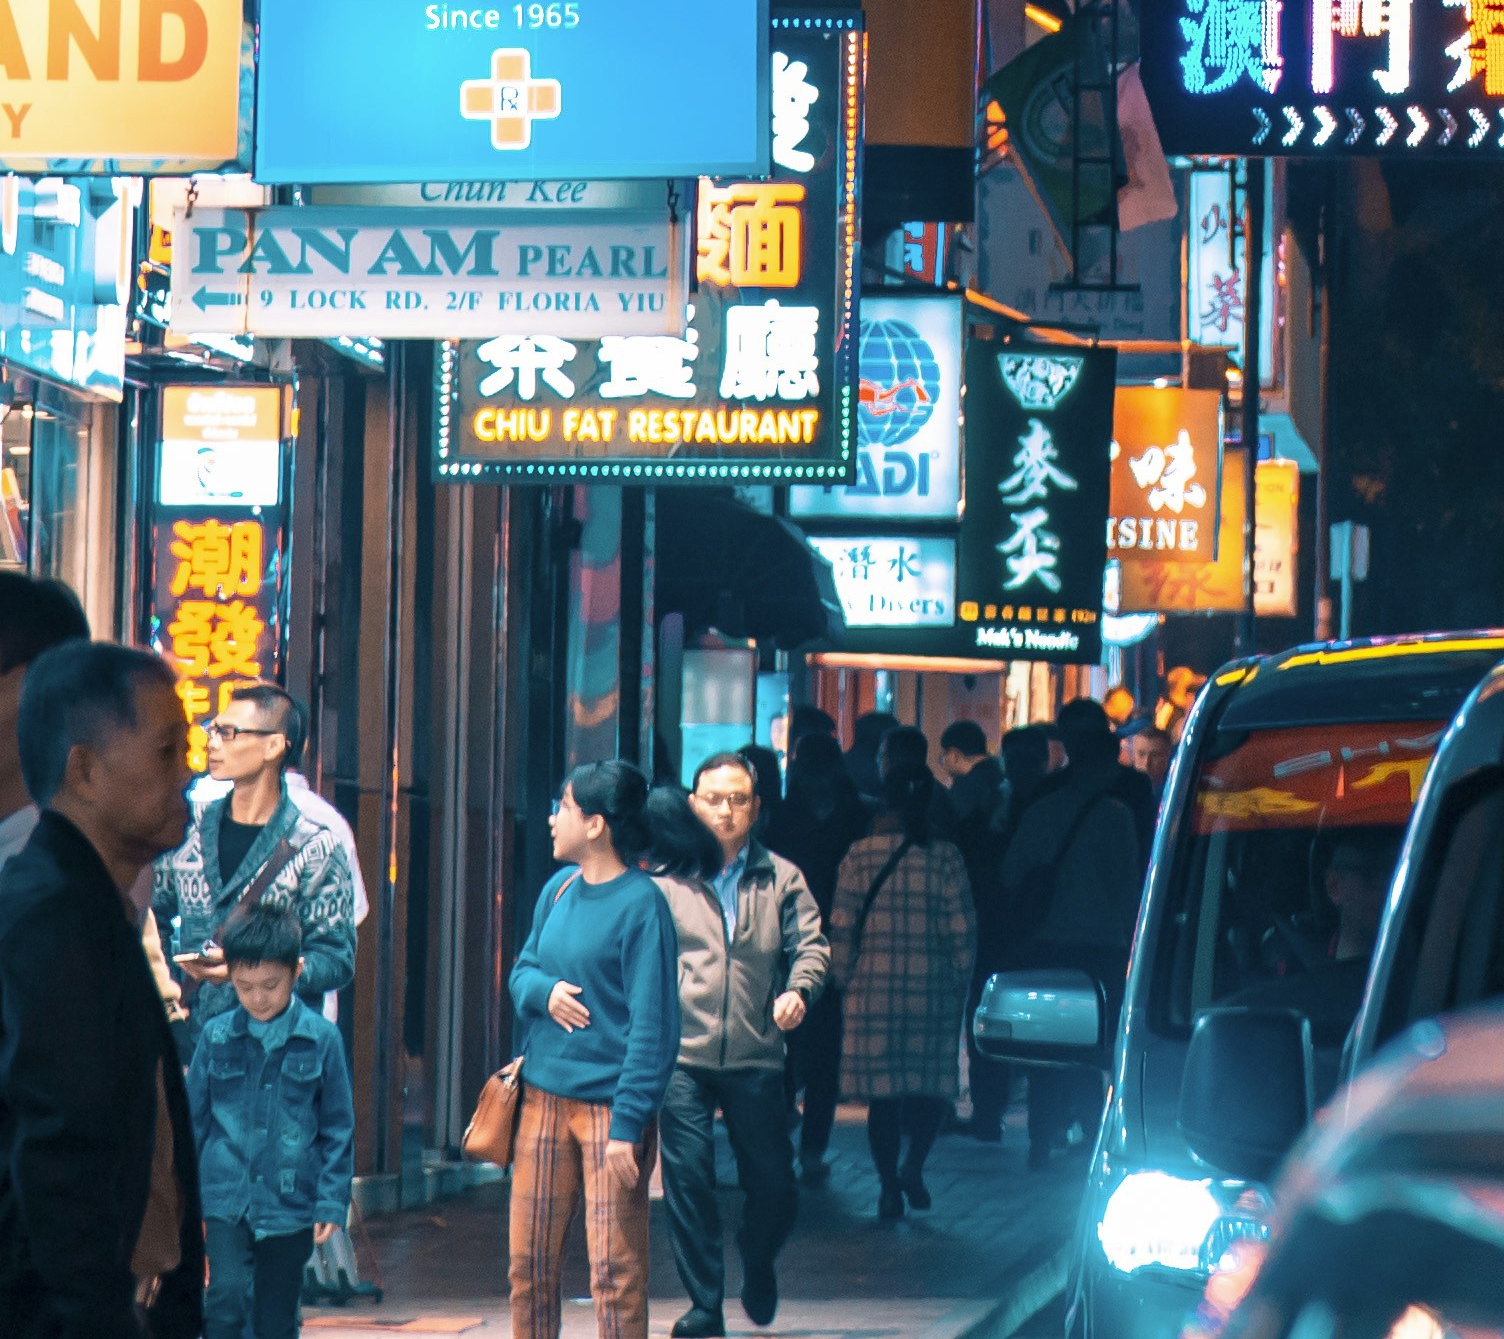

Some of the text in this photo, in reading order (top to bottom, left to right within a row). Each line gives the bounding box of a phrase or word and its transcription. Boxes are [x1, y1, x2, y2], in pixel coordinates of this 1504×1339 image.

[424, 2, 581, 32] Since 1965
[191, 225, 669, 279] PAN AM PEARL
[259, 289, 666, 315] 9 LOCK RD. 2/F FLORIA YIU
[475, 406, 819, 444] CHIU FAT RESTAURANT
[822, 449, 931, 497] ADI
